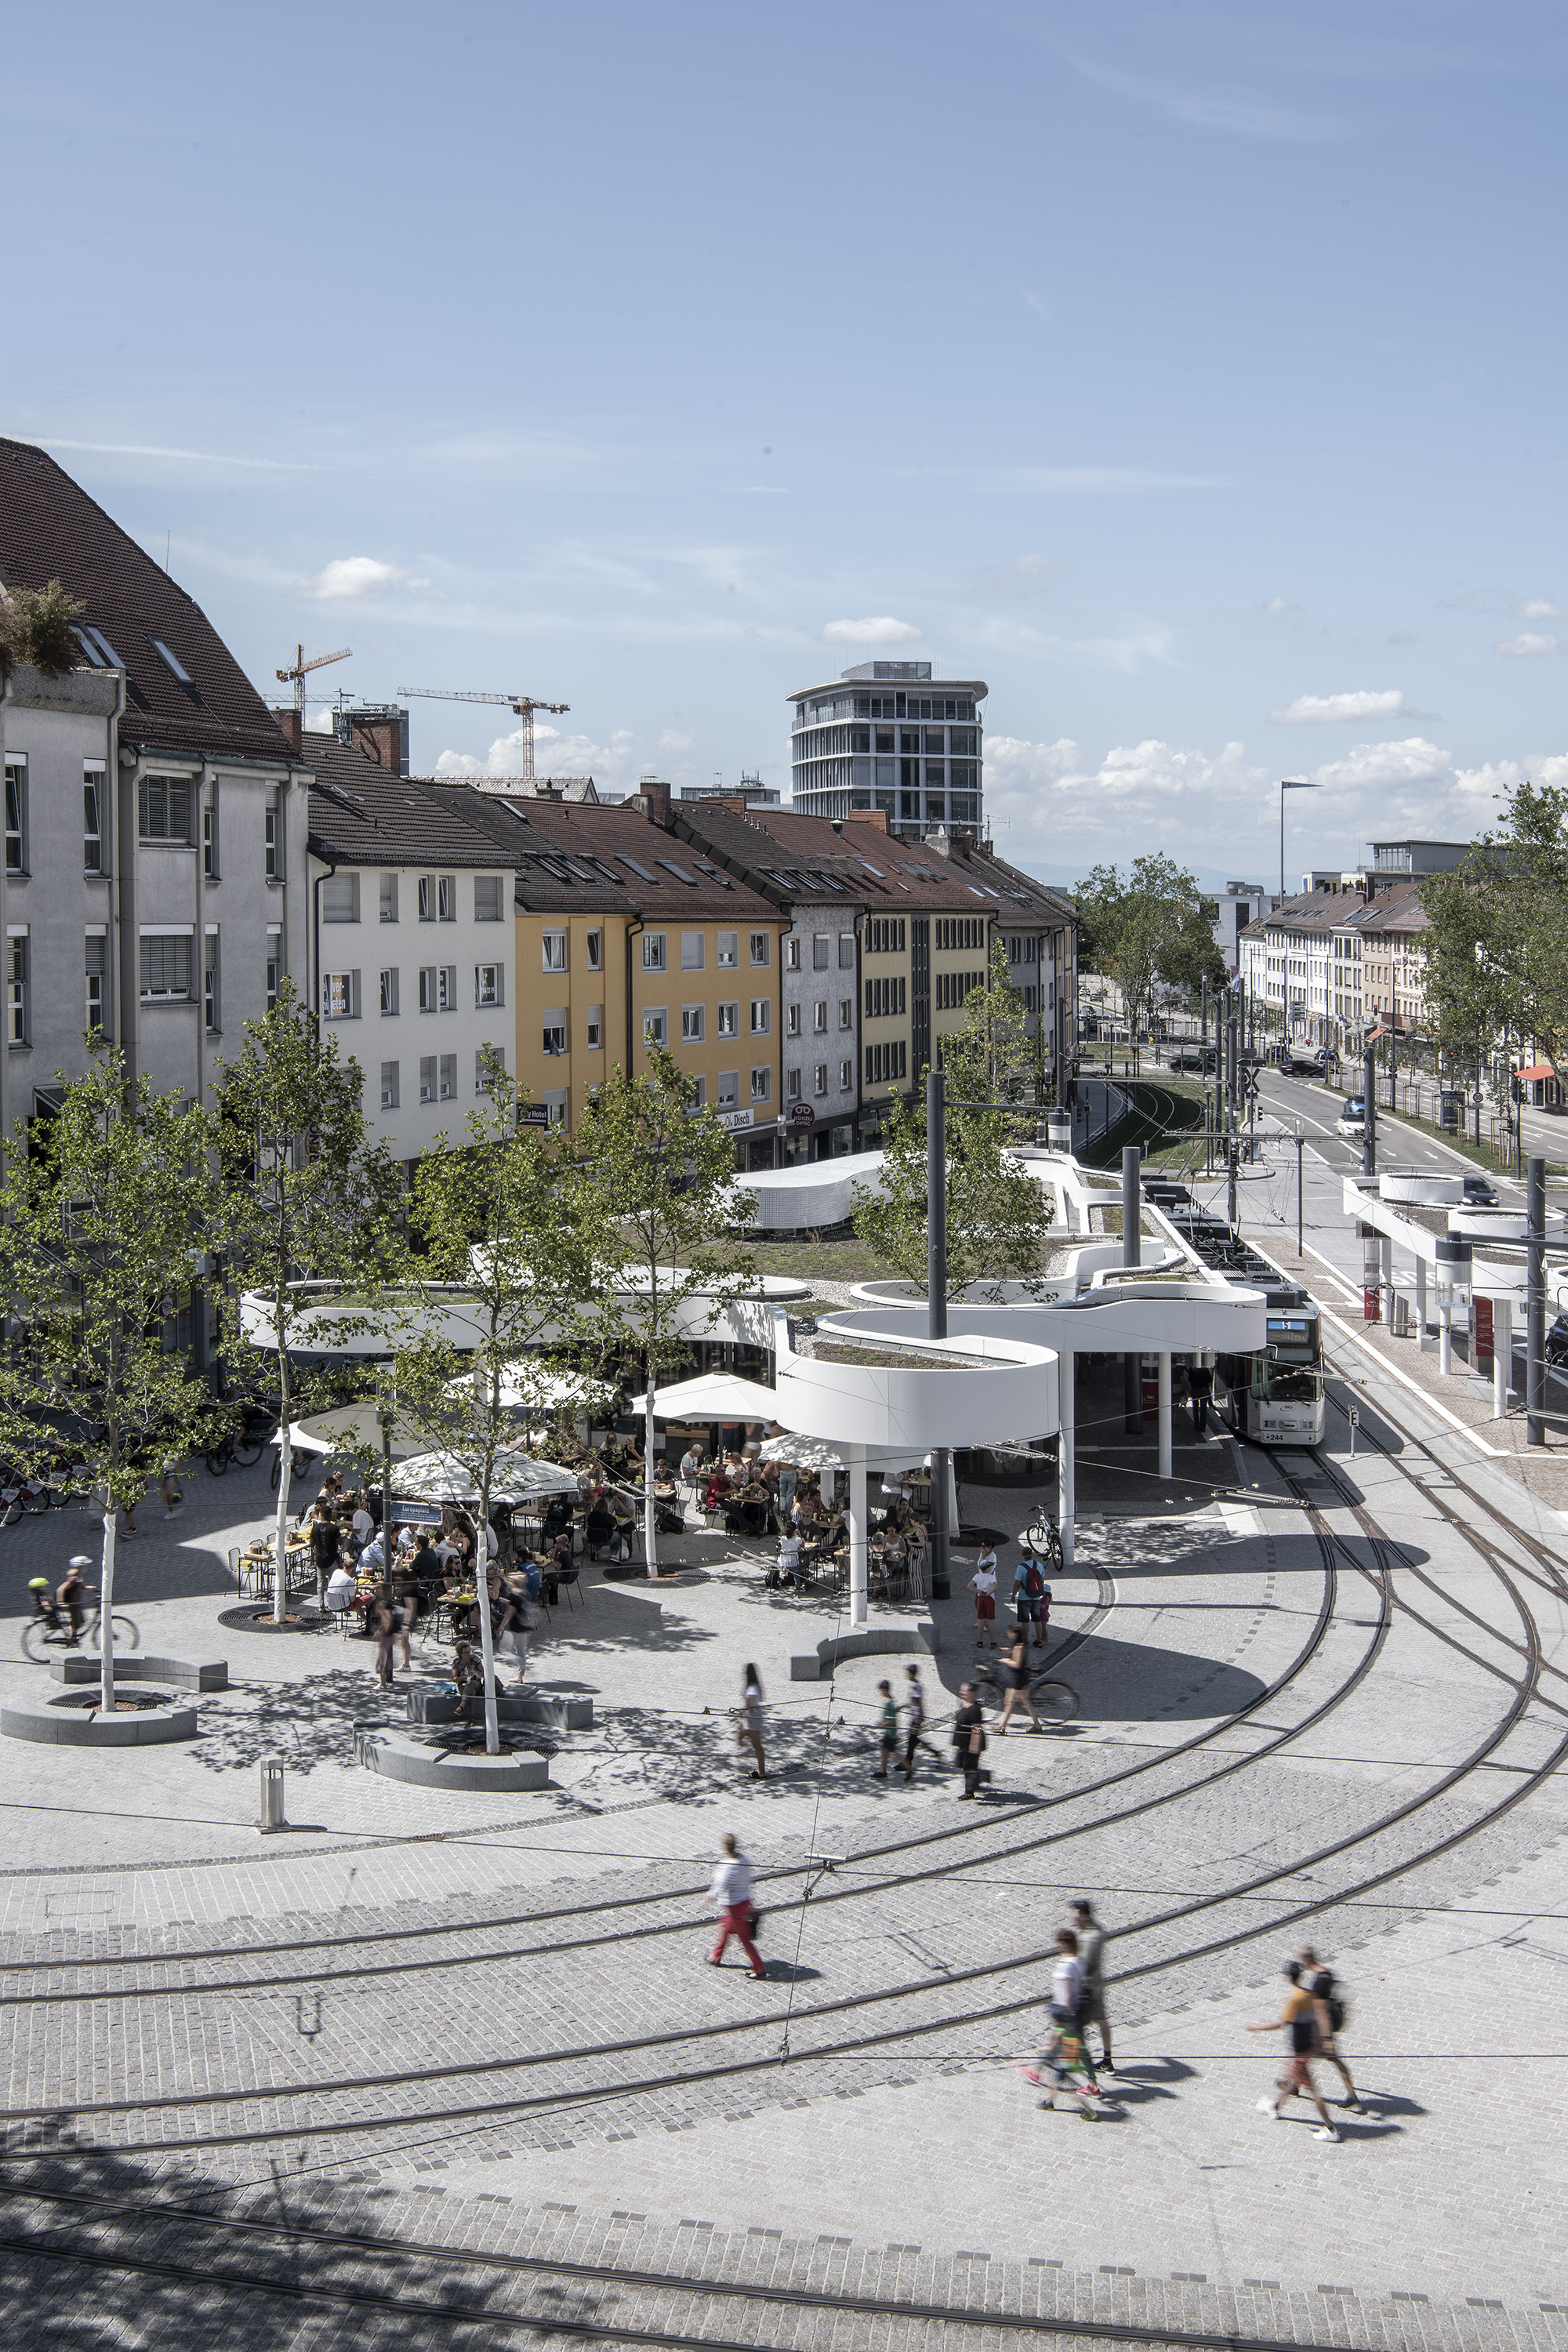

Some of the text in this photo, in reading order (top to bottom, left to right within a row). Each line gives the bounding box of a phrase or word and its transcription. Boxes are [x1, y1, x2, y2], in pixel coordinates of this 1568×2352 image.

[332, 982, 345, 993] ver-
[734, 1112, 750, 1127] Disch
[1351, 1412, 1357, 1425] E
[401, 1505, 430, 1514] Europaplatz
